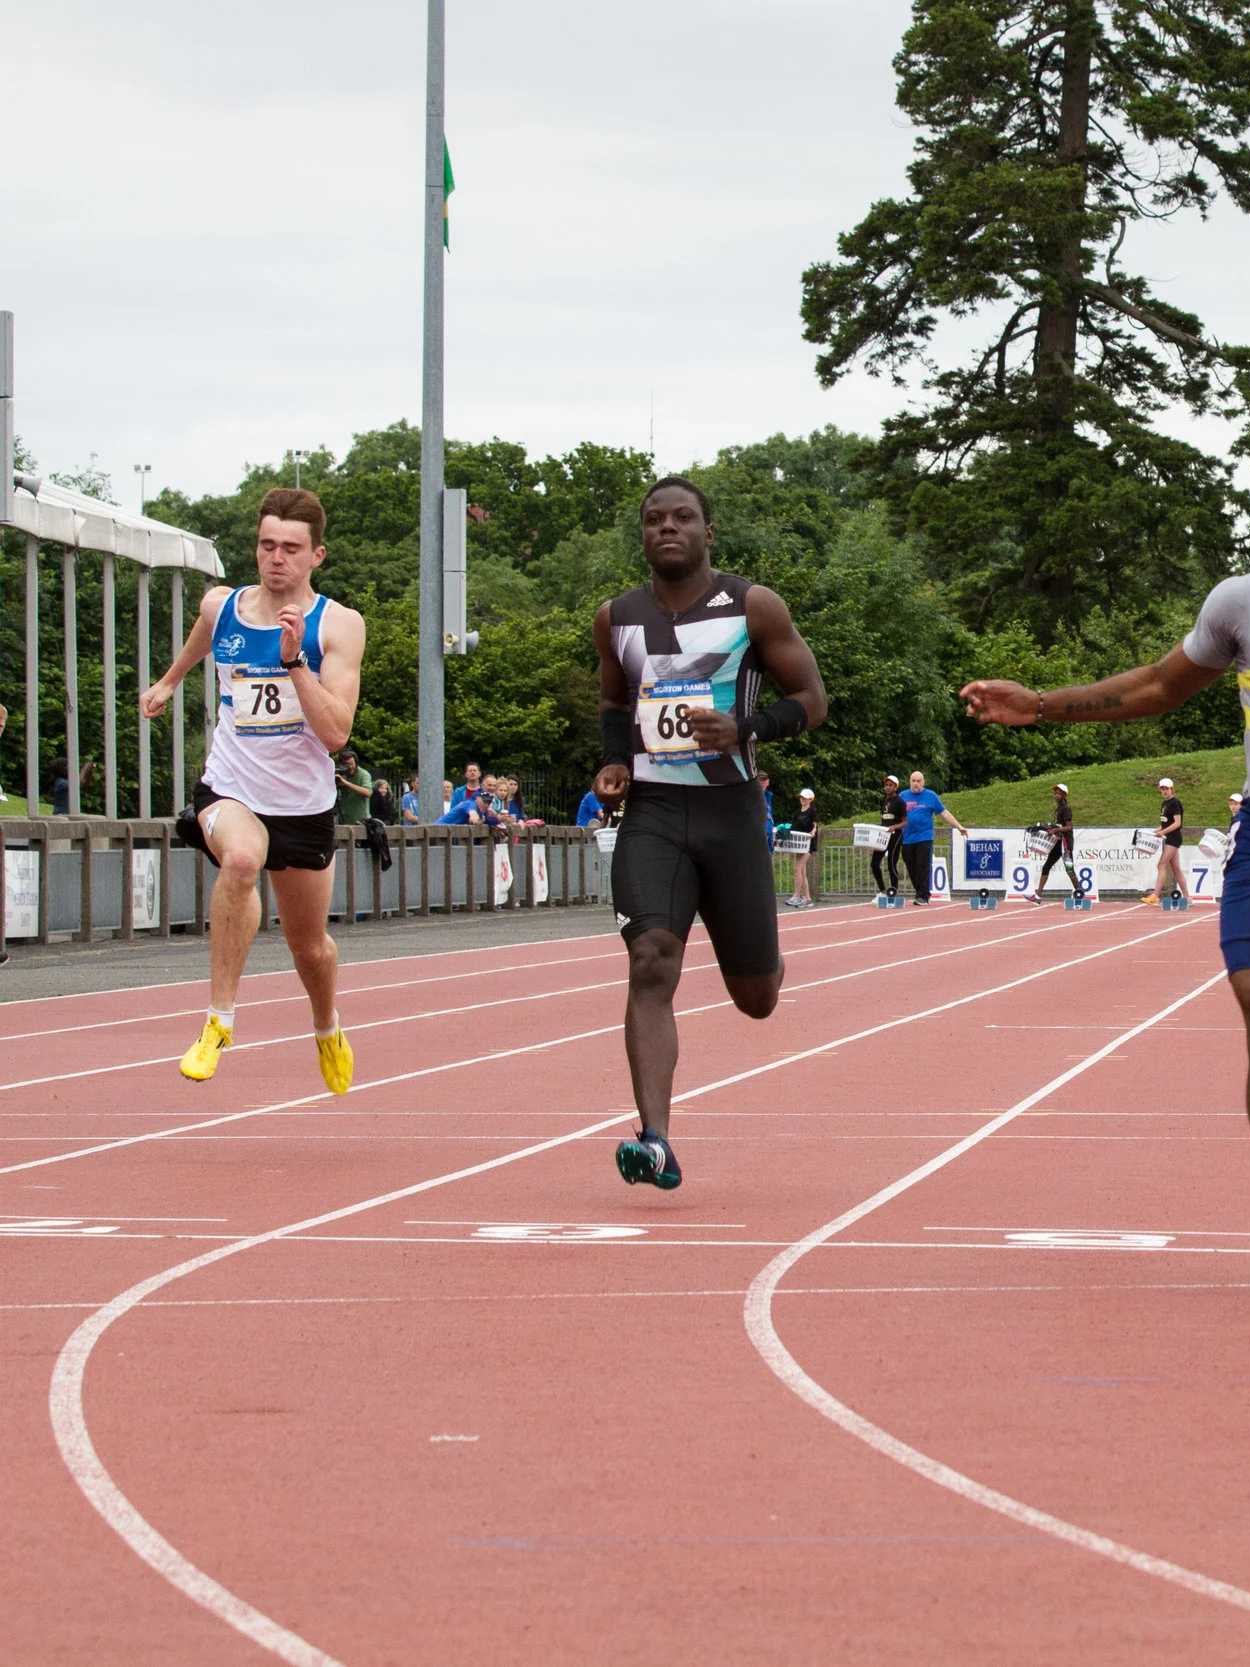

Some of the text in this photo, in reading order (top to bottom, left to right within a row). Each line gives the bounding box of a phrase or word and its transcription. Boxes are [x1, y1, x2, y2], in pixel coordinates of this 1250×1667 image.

[250, 683, 282, 716] 78
[653, 681, 711, 694] MORTON GAMES
[657, 703, 695, 740] 68
[969, 843, 1000, 852] BEHAN
[1012, 866, 1030, 892] 9
[1078, 867, 1093, 892] 8
[1192, 868, 1209, 894] 7
